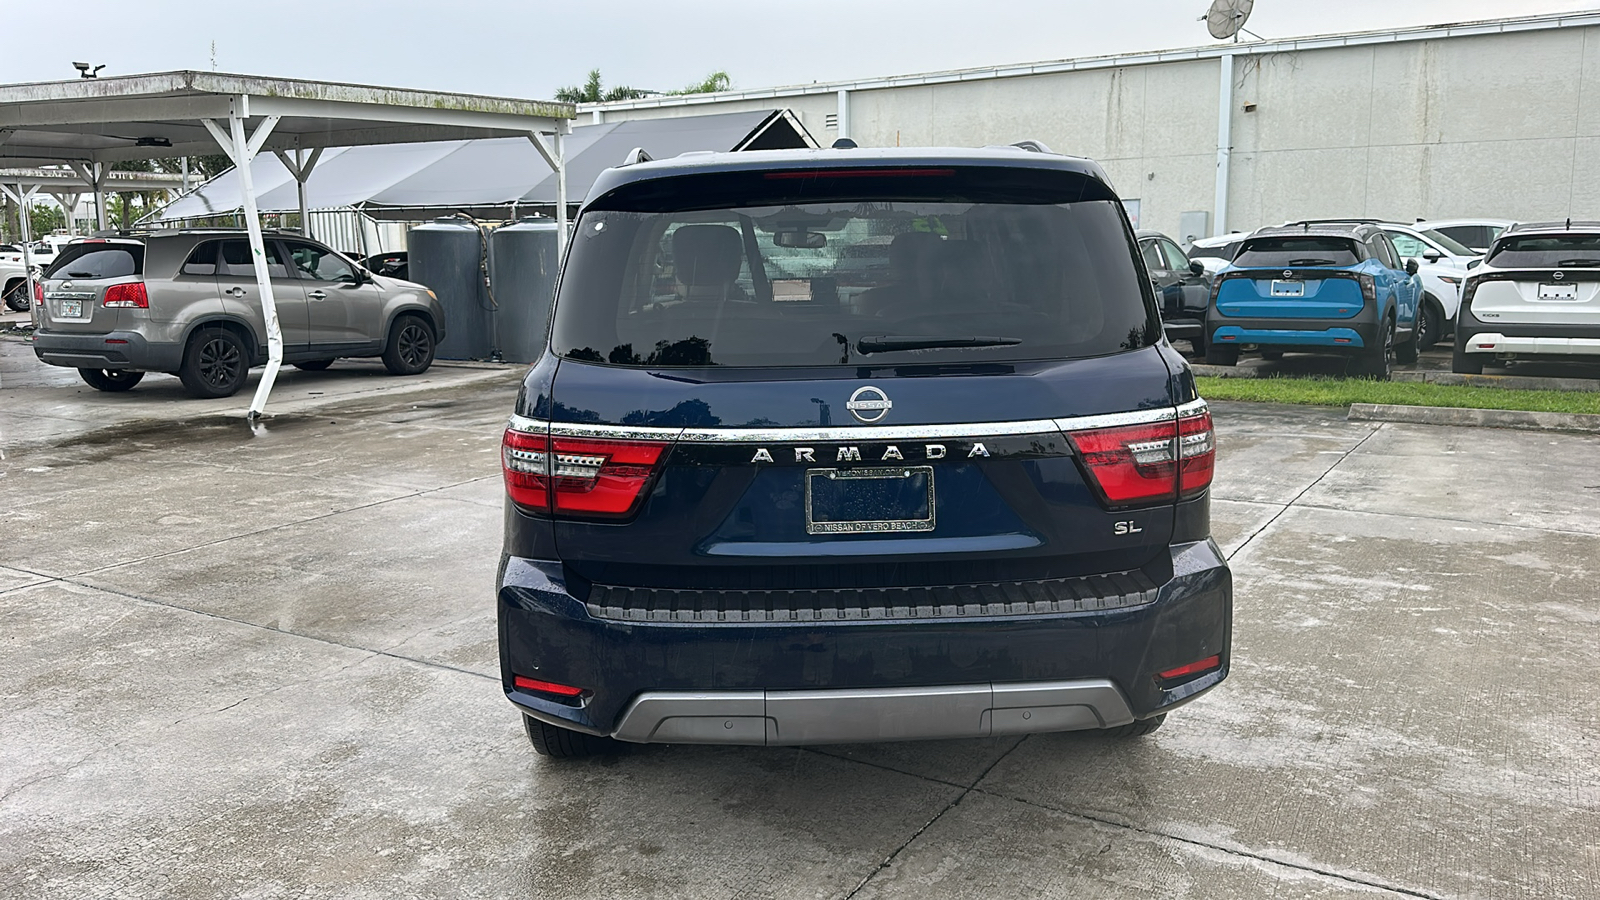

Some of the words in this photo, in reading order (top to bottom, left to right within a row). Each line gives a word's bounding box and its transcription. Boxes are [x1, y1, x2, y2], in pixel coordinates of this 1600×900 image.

[847, 401, 892, 409] NISSAN
[751, 442, 990, 463] ARMADA
[837, 469, 902, 477] VERONISSAN.COM
[824, 523, 854, 532] NISSAN
[855, 523, 866, 531] OF
[867, 522, 889, 531] VERO
[891, 521, 918, 530] BEACH
[1114, 520, 1143, 535] SL
